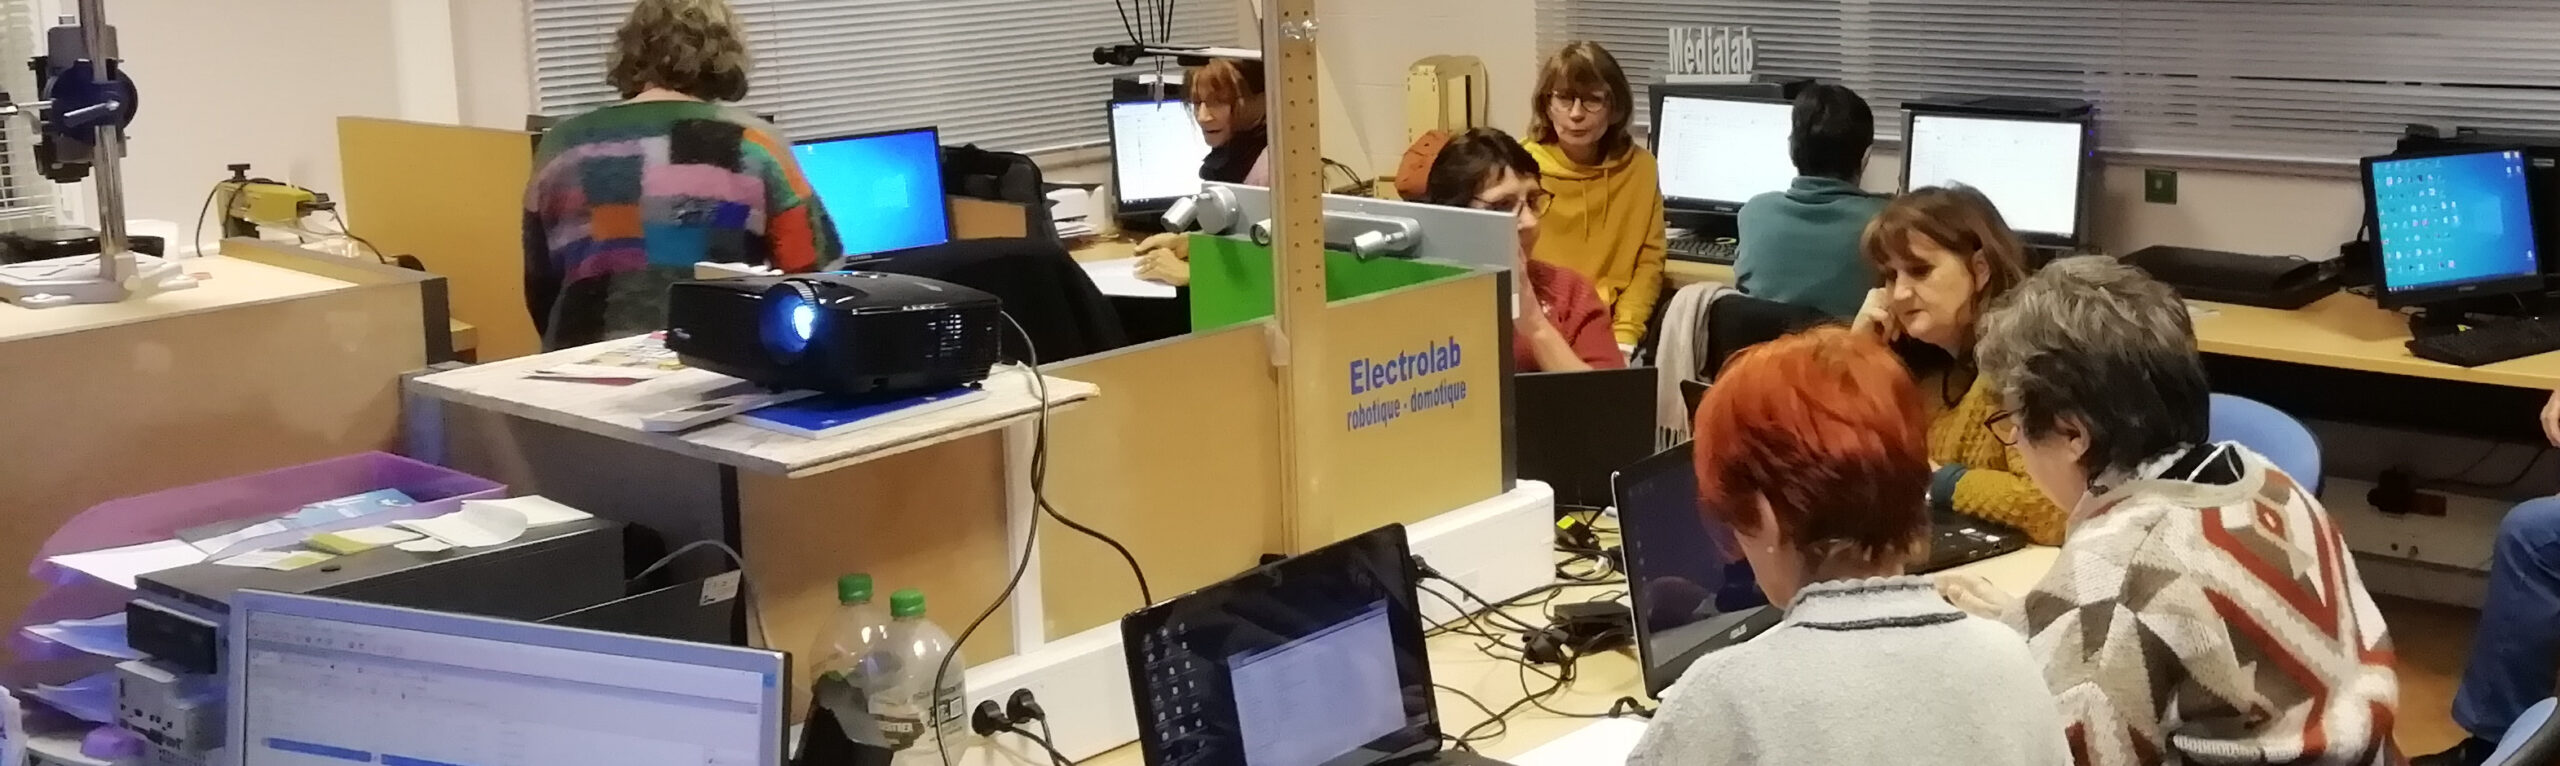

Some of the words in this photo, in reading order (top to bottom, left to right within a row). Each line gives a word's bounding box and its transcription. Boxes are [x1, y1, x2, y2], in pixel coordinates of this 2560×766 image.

[1668, 26, 1753, 75] Médialab
[1350, 336, 1461, 395] Electrolab
[1347, 398, 1401, 431] robotique
[1410, 379, 1466, 412] domotique
